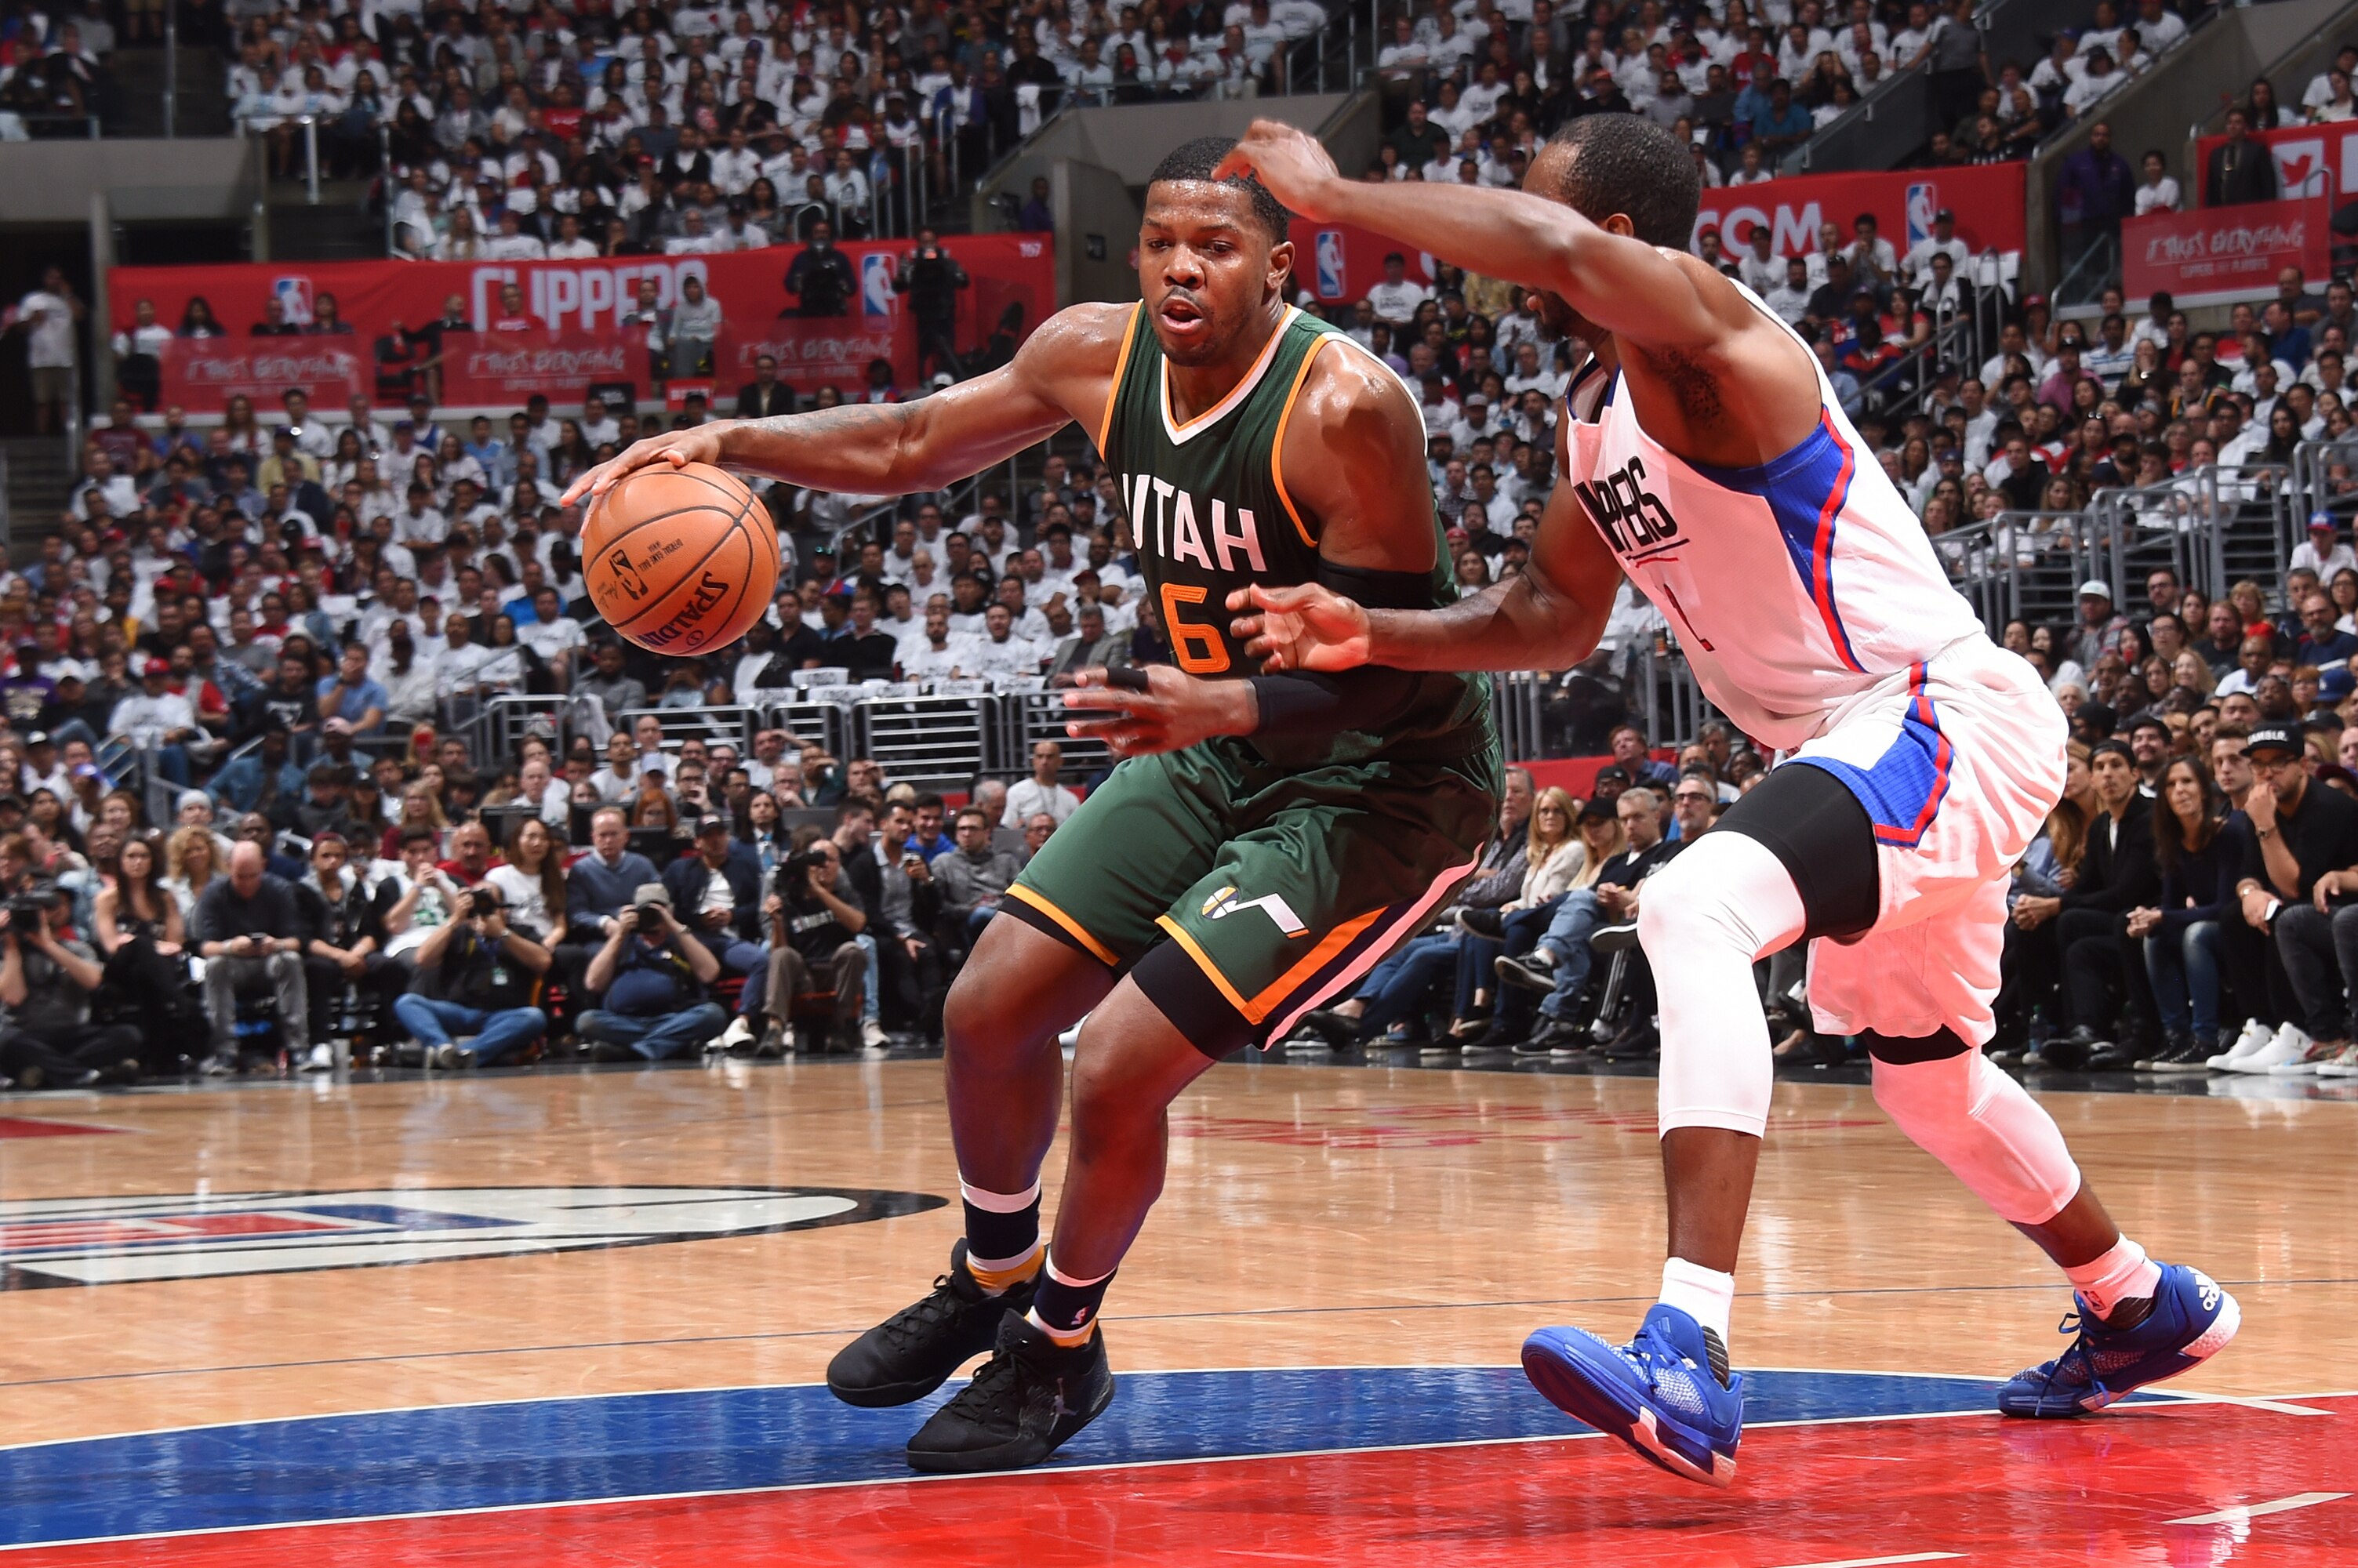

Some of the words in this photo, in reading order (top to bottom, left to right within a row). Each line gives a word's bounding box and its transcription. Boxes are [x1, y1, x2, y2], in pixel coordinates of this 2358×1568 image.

[1122, 473, 1268, 572] UTAH
[637, 571, 728, 647] SPALDIN
[1160, 583, 1230, 673] 6
